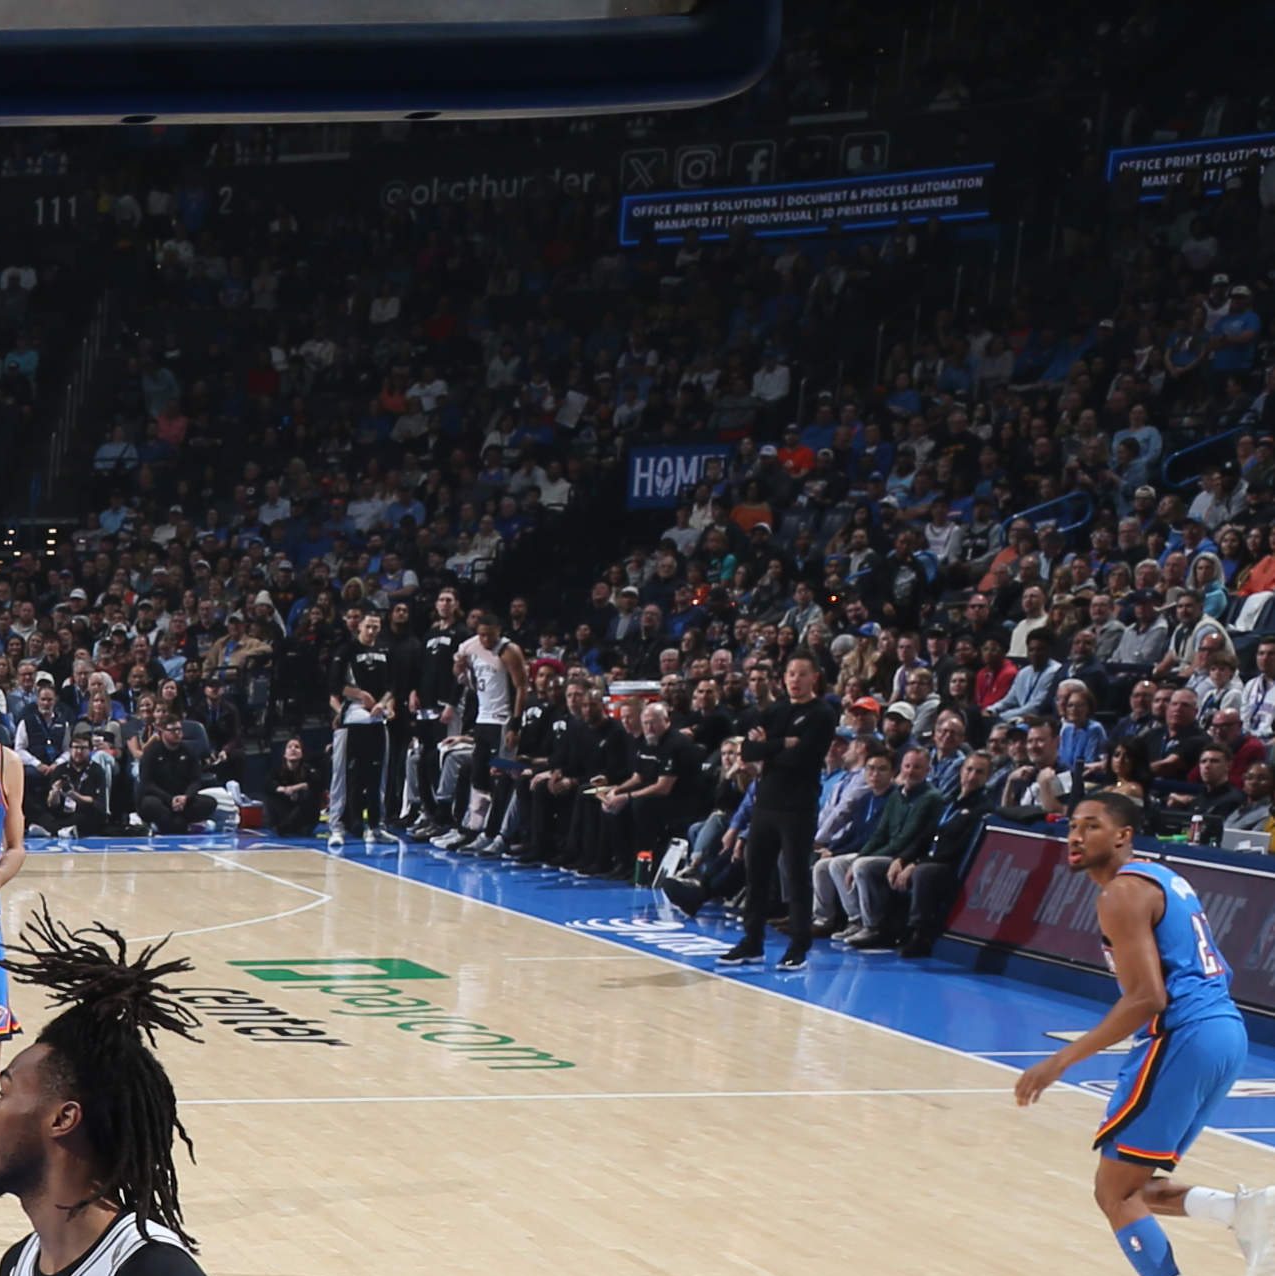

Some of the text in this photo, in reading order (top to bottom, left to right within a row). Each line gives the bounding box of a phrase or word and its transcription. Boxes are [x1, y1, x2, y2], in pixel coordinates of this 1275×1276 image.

[1164, 153, 1203, 169] PRINT
[35, 195, 77, 225] 111
[631, 176, 984, 218] OFFICE PRINT SOLUTIONS DOCUMENT & PROCESS AUTOMATION
[654, 215, 709, 231] MANAGED
[711, 215, 724, 228] IT
[821, 206, 836, 219] 3D
[836, 201, 889, 217] PRINTERS
[901, 194, 959, 212] SCANNERS
[281, 985, 575, 1070] paycom
